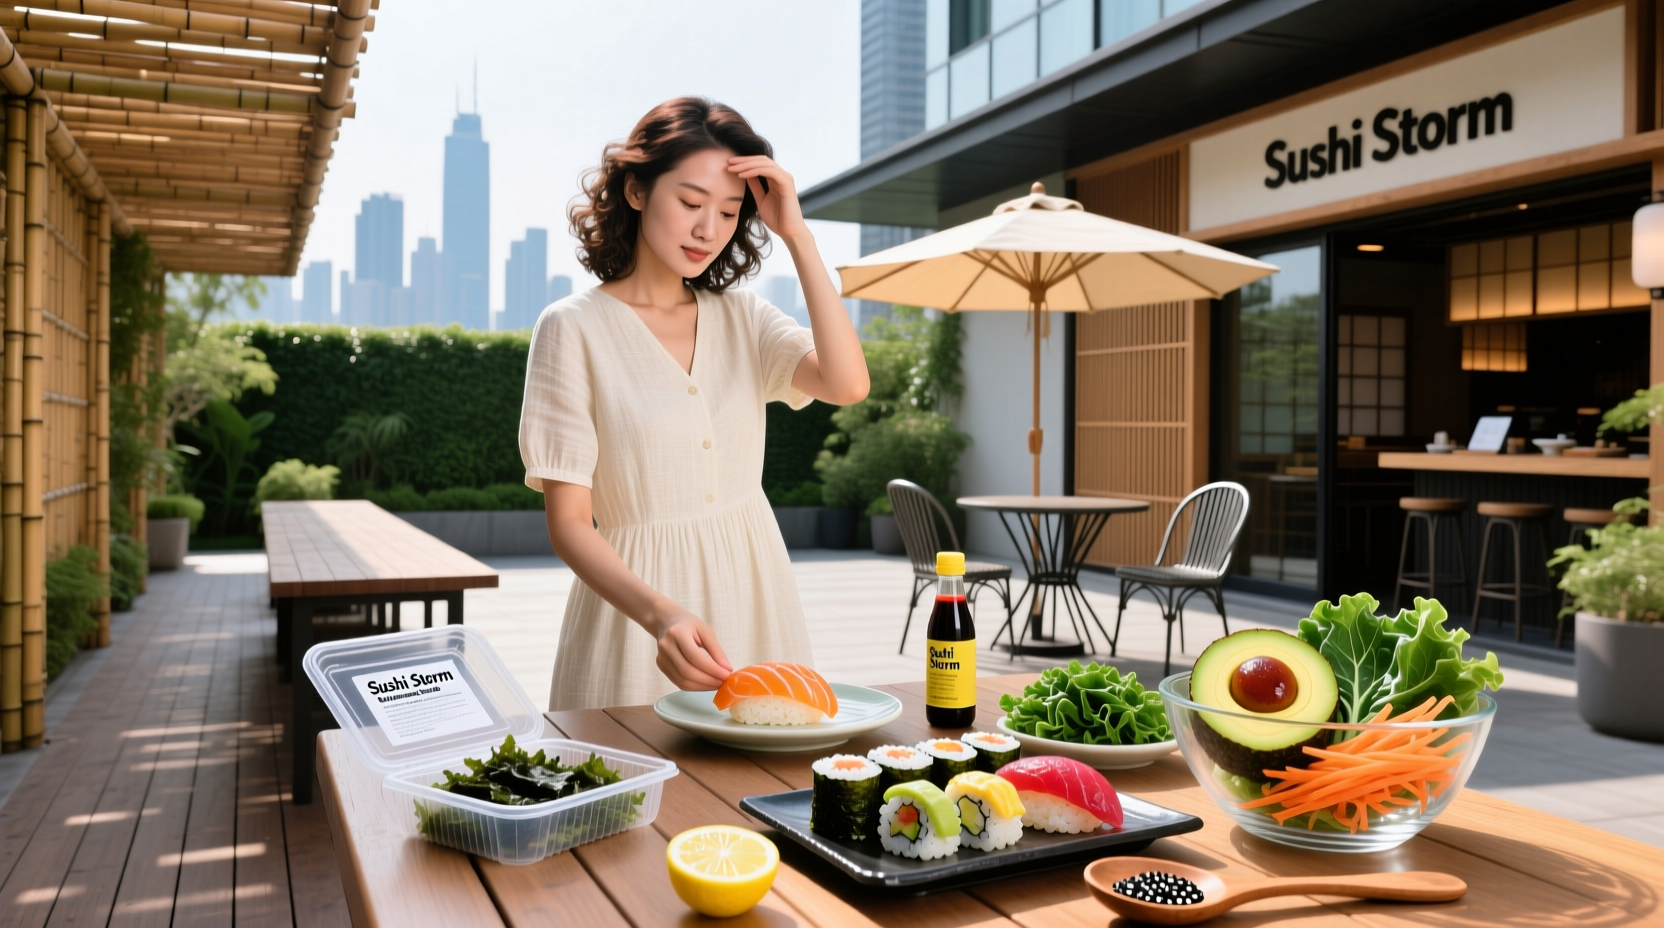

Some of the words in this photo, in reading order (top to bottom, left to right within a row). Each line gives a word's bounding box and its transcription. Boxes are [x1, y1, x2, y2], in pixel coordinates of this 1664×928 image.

[1264, 118, 1363, 189] Sushi
[1372, 92, 1513, 162] Storm
[368, 675, 410, 695] Sushi
